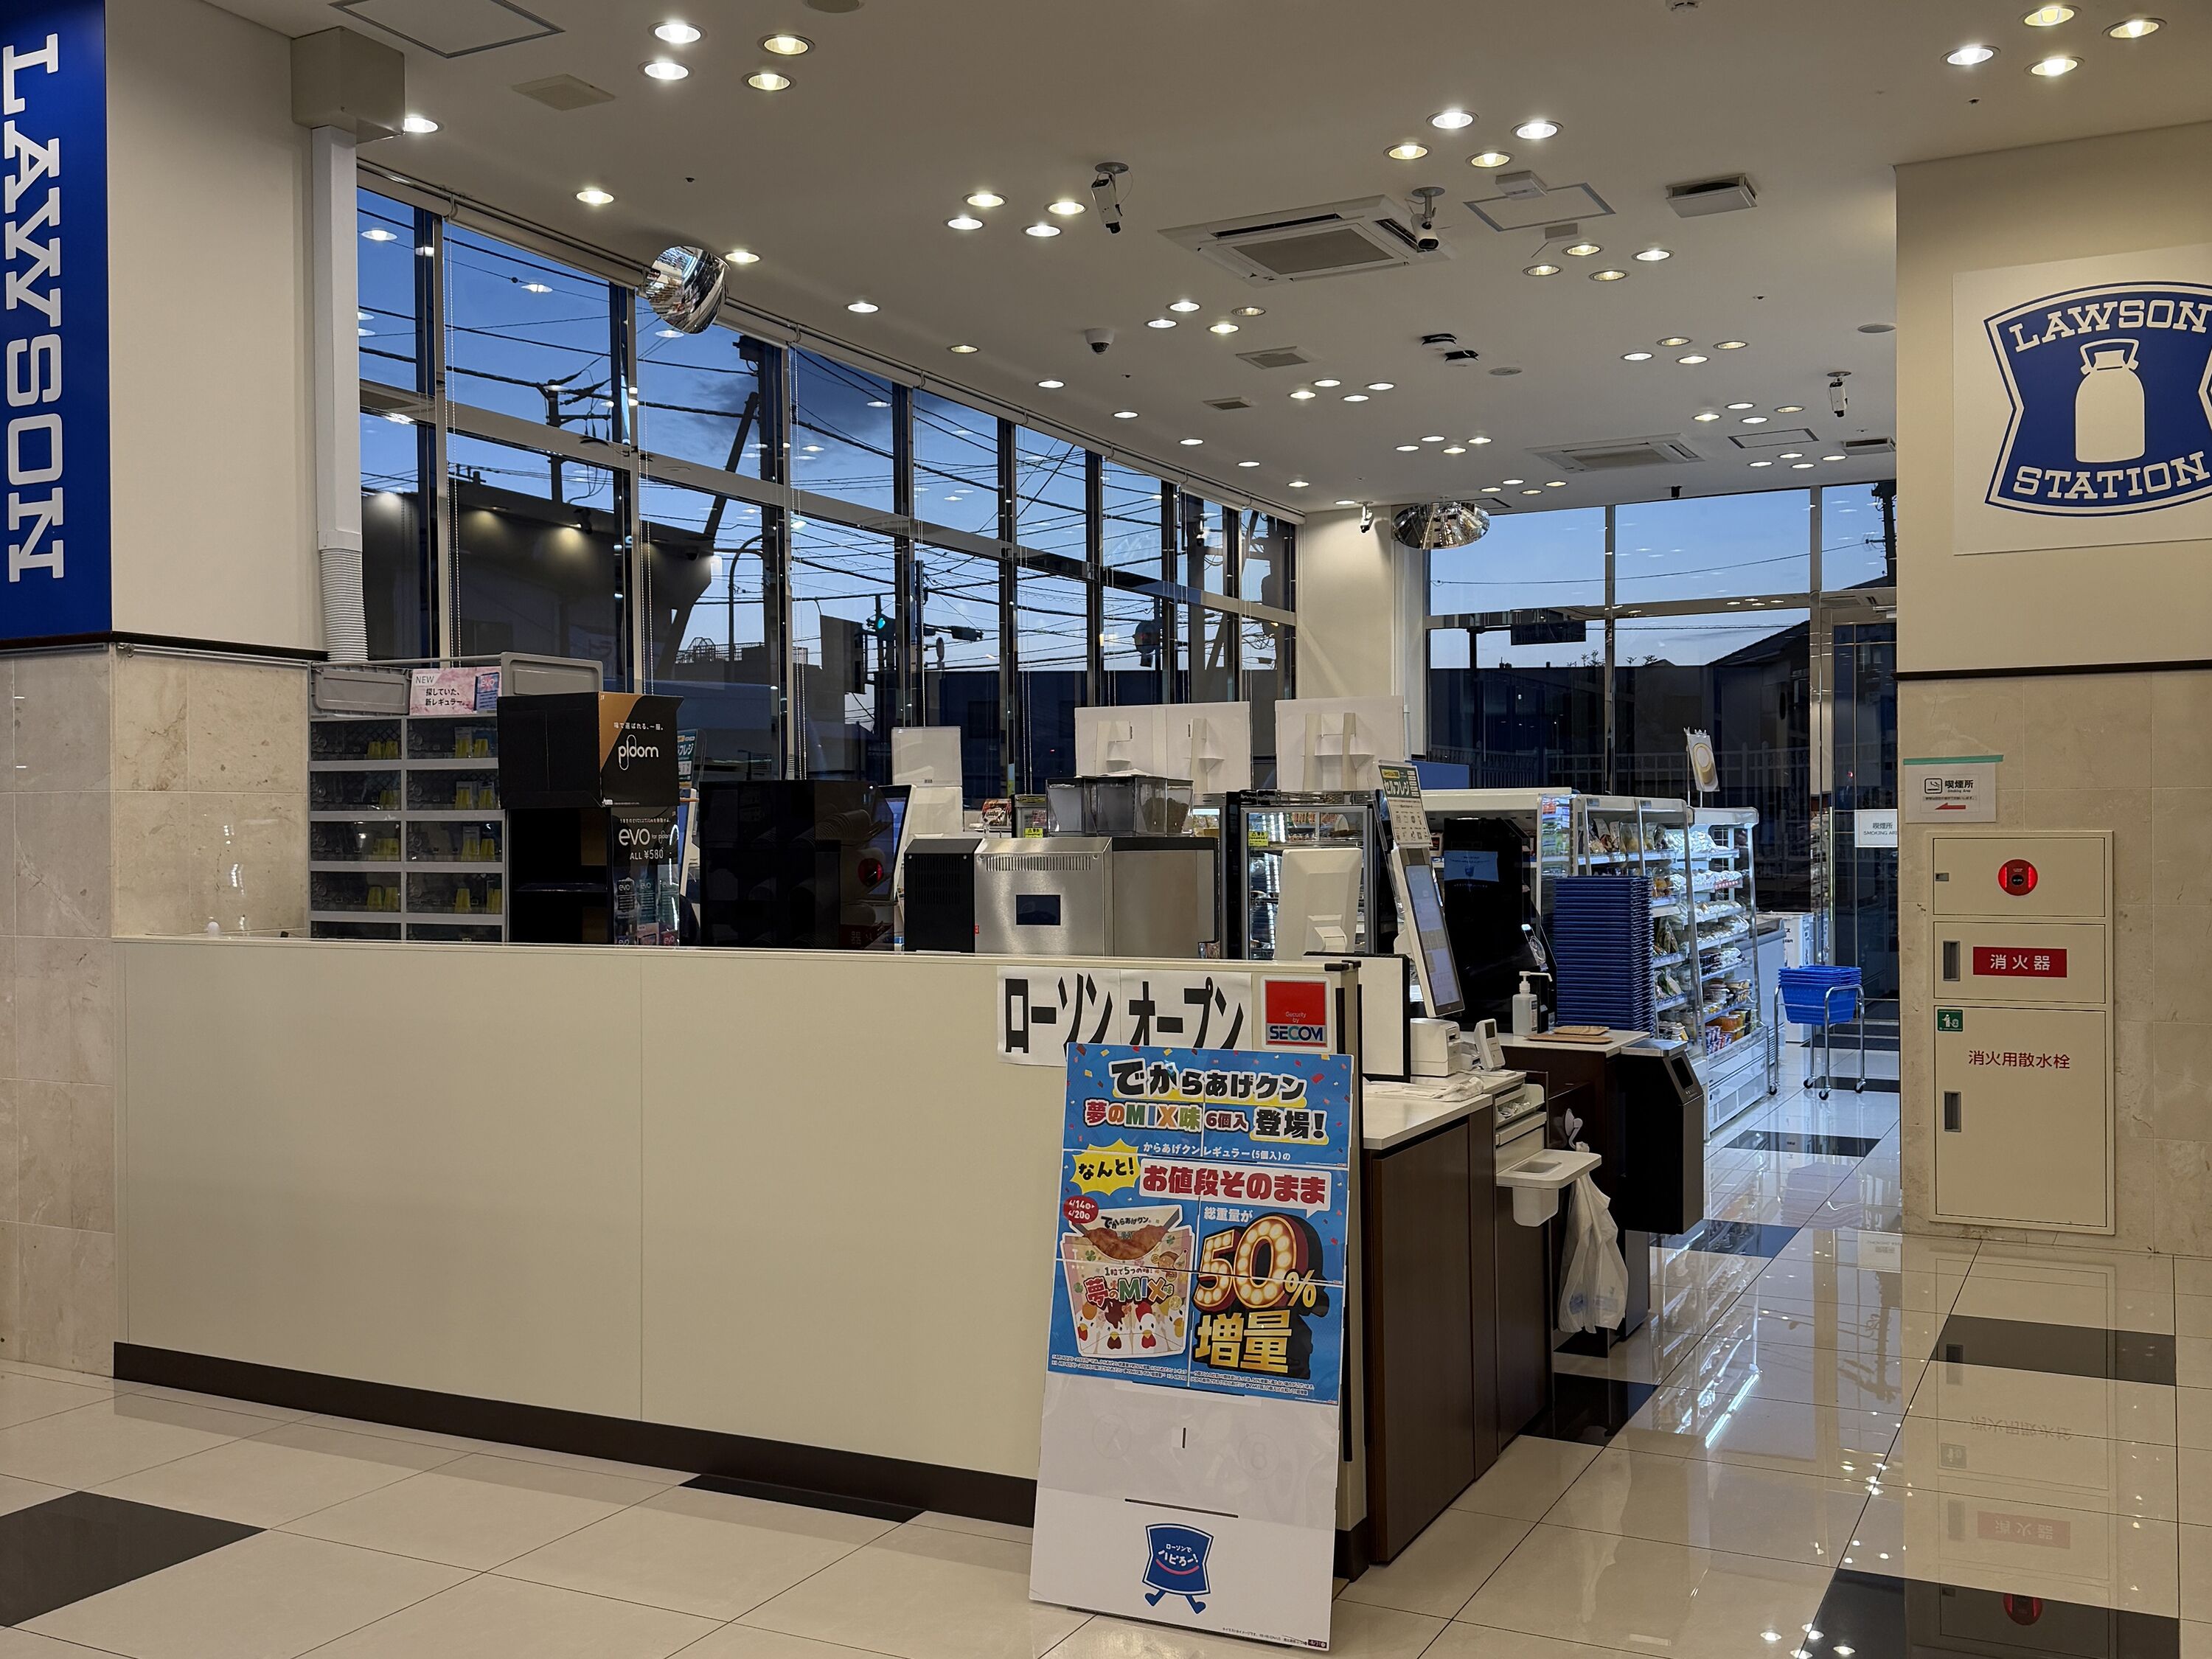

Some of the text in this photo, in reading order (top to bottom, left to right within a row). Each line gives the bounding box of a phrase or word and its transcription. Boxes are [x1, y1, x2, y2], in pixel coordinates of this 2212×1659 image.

[3, 33, 64, 582] LAWSON
[2009, 299, 2212, 352] LAWSON
[2013, 451, 2211, 500] STATION
[416, 675, 434, 684] NEW
[618, 734, 659, 771] ploom
[1384, 780, 1410, 796] セルフレジ
[1944, 779, 1974, 789] 喫煙所
[619, 828, 650, 846] evo
[630, 849, 664, 860] ALL ¥580
[1990, 954, 2051, 971] 消火器
[1005, 973, 1244, 1054] ローソン オープン
[1285, 1011, 1307, 1019] Security
[1269, 1025, 1324, 1042] SECOM
[1969, 1050, 2070, 1069] 消火用散水栓
[1111, 1060, 1305, 1102] でからあげクン
[1085, 1101, 1201, 1130] 夢のMIX味
[1204, 1112, 1248, 1130] 6個入
[1078, 1156, 1135, 1181] なんと!
[1142, 1164, 1326, 1205] お値段そのまま
[1204, 1206, 1253, 1222] 総重量が
[1193, 1216, 1317, 1309] 50%
[1194, 1309, 1293, 1374] 増量
[1166, 1543, 1192, 1553] ローソンで
